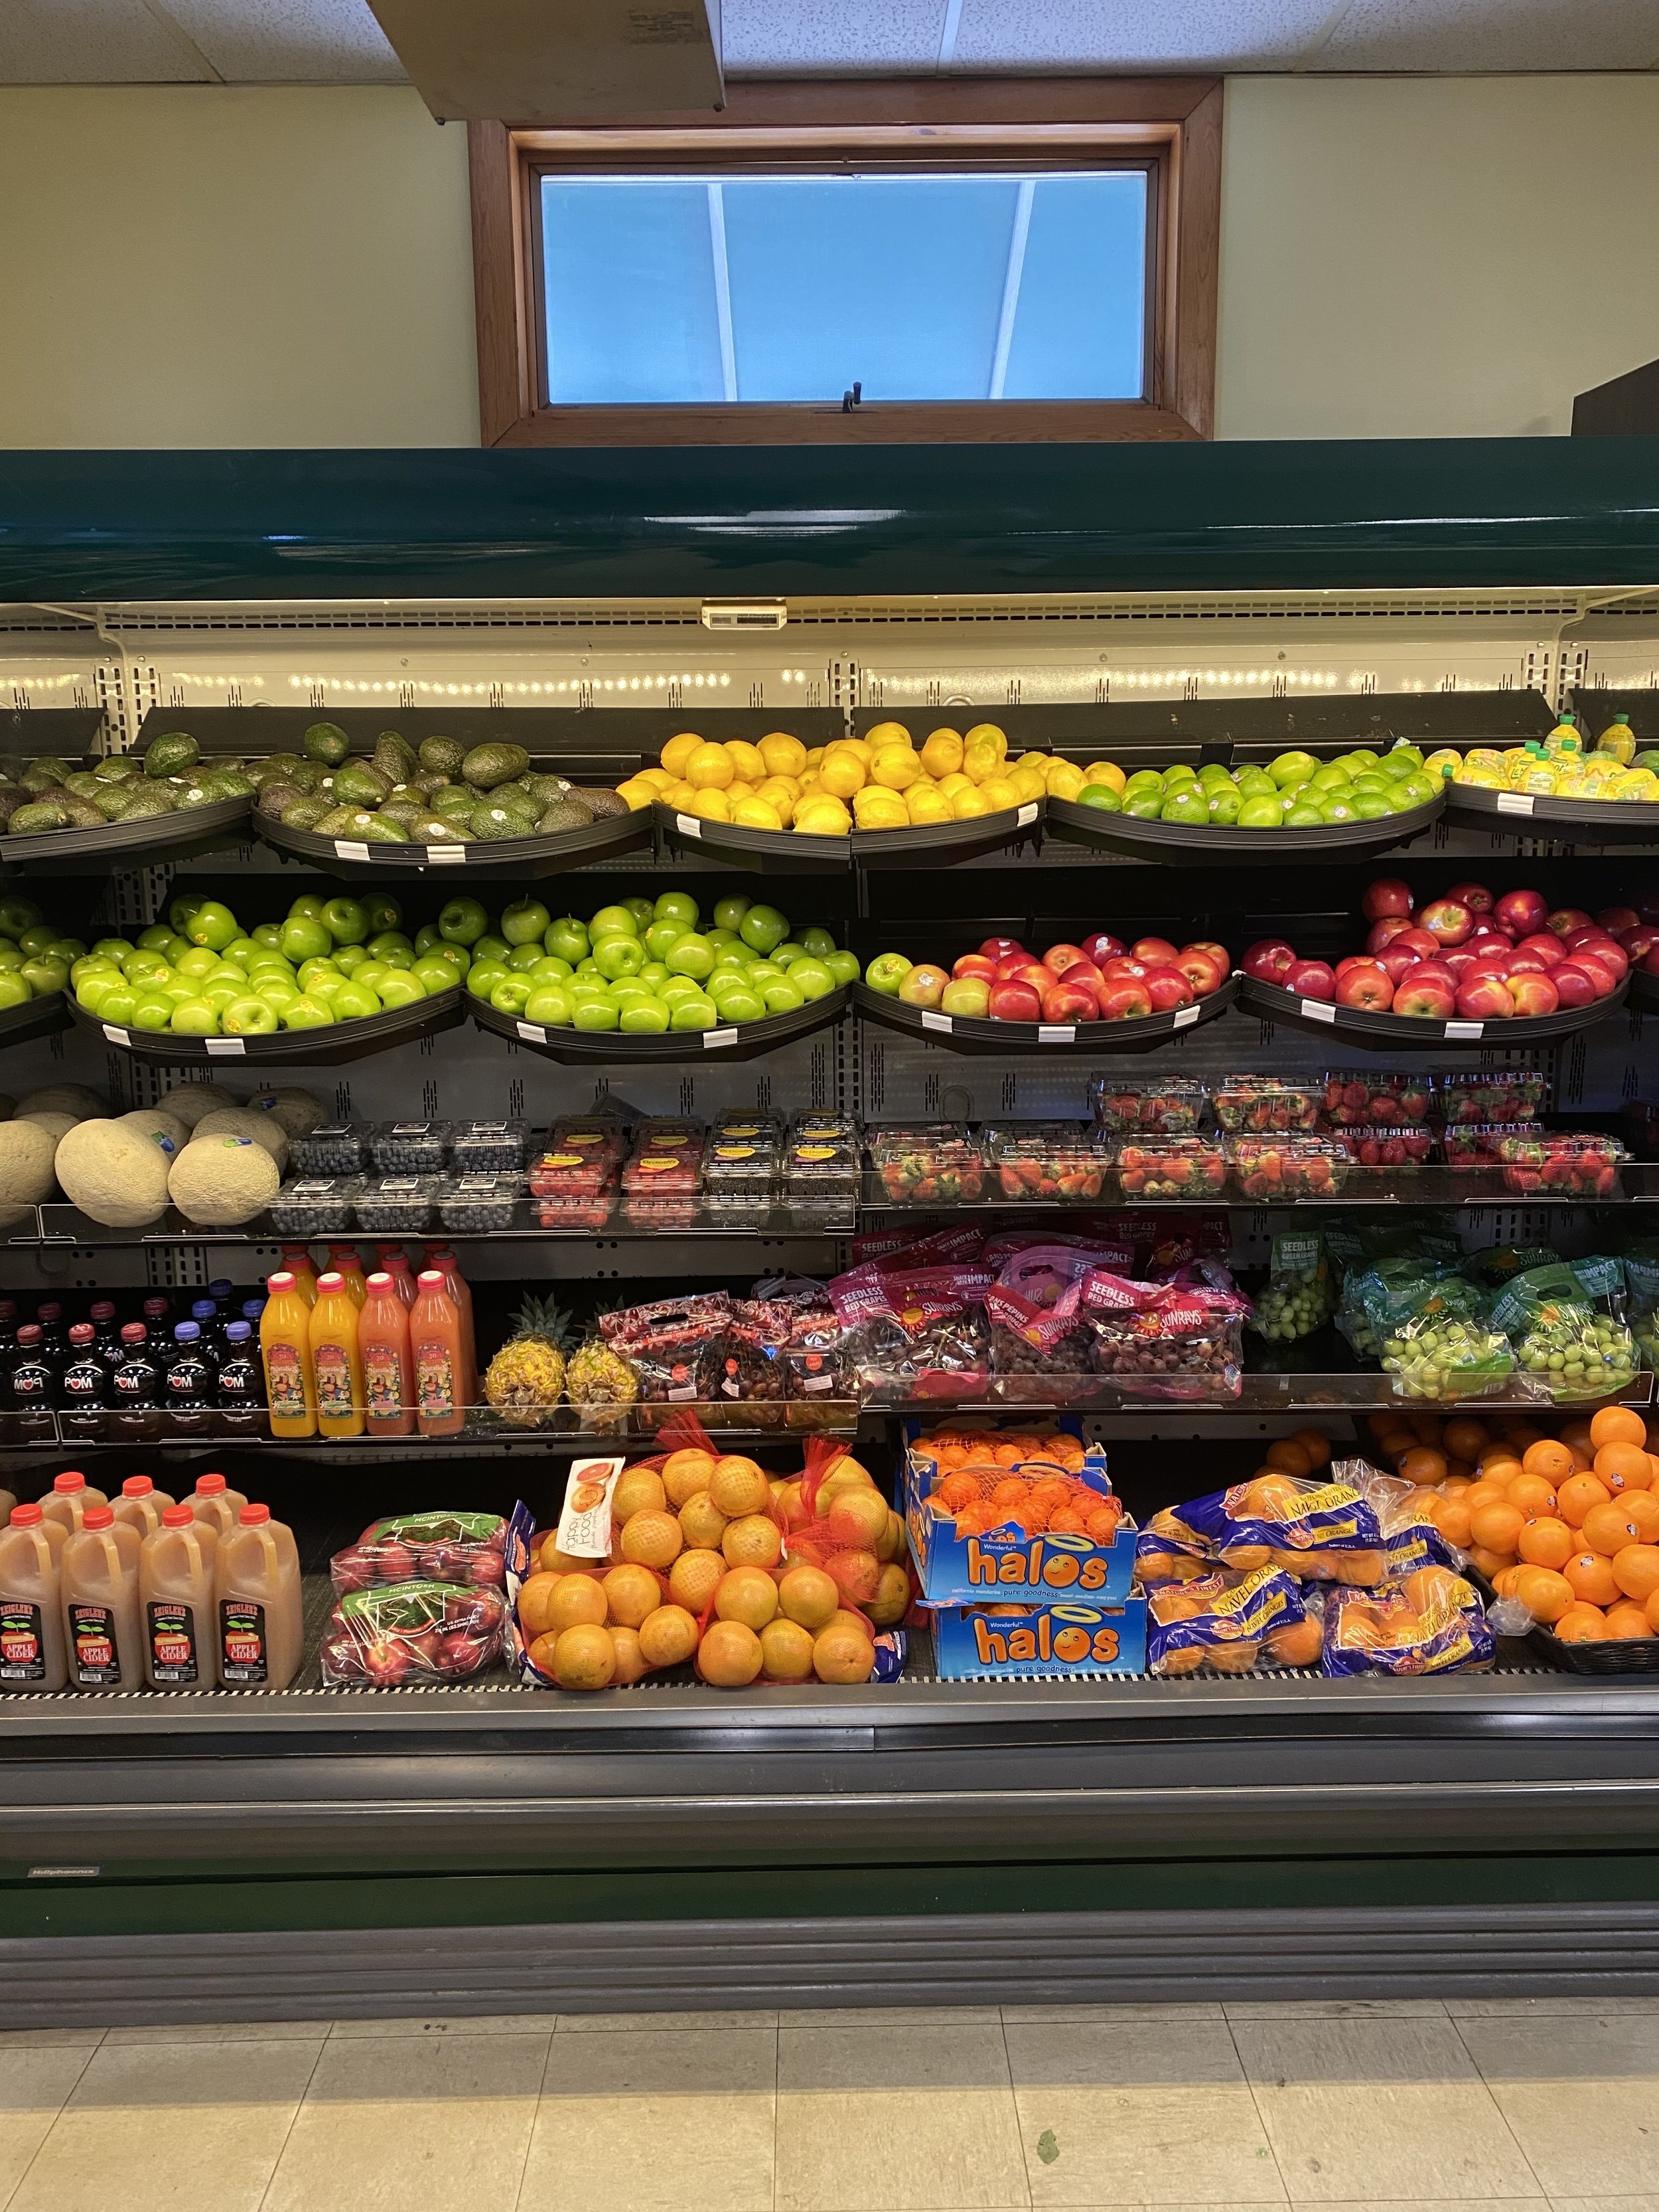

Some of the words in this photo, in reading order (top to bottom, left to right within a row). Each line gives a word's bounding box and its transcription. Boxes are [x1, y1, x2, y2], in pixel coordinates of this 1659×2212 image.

[950, 1230, 982, 1251] IMPACT
[1282, 1240, 1319, 1252] SEEDLESS
[1587, 1260, 1617, 1278] IMPACT
[967, 1274, 995, 1285] IMPACT
[843, 1286, 884, 1304] SEEDLESS
[1088, 1293, 1102, 1304] RED
[1090, 1281, 1135, 1307] SEEDLESS
[844, 1300, 859, 1313] RED
[861, 1295, 888, 1307] GRAPES
[922, 1301, 963, 1315] SUNRAYS
[1558, 1301, 1594, 1320] SUNRAYS
[1160, 1309, 1202, 1329] SUNRAYS
[1038, 1315, 1079, 1341] SUNRAYS
[647, 1335, 673, 1344] CHERRIES
[64, 1376, 94, 1389] POM
[113, 1374, 139, 1388] POM
[167, 1374, 193, 1388] POM
[219, 1374, 245, 1388] POM
[967, 1537, 1109, 1589] halos
[1003, 1589, 1021, 1598] pure
[1023, 1589, 1058, 1599] goodness
[1159, 1586, 1196, 1596] NATURE'S
[1196, 1582, 1221, 1592] FINEST
[1218, 1585, 1254, 1615] NAVEL
[1247, 1618, 1263, 1633] NAVEL
[1263, 1599, 1284, 1620] ORANGES
[974, 1614, 1120, 1664] halos
[7, 1650, 35, 1659] CIDER
[83, 1654, 110, 1662] CIDER
[160, 1651, 188, 1660] CIDER
[230, 1651, 259, 1659] CIDER
[1037, 1664, 1072, 1673] goodness
